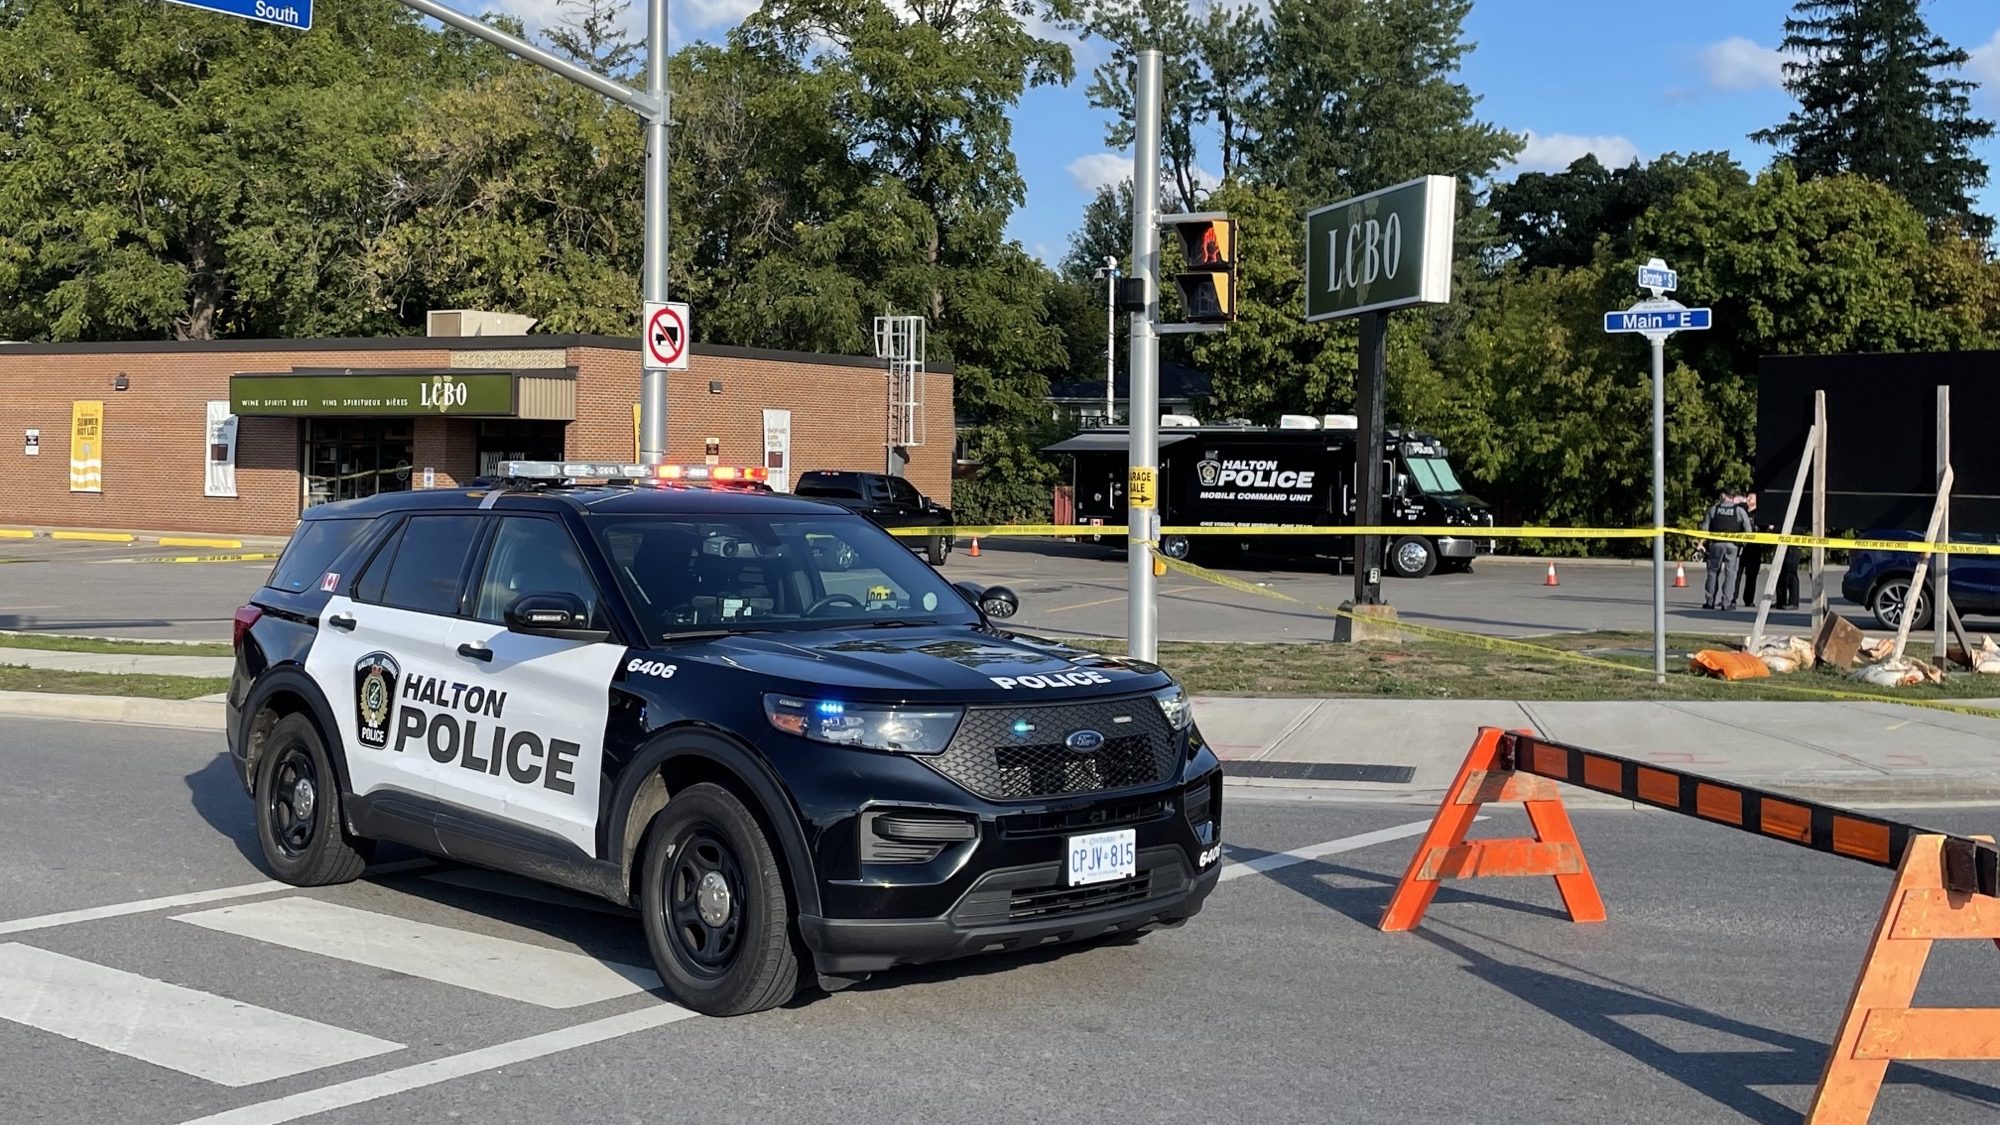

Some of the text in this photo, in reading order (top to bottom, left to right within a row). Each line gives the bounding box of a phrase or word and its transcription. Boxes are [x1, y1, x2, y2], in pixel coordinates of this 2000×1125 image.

[255, 0, 298, 23] South
[1327, 212, 1401, 292] LCBO
[1642, 270, 1663, 286] Bronte
[1668, 273, 1673, 288] S
[1623, 314, 1662, 329] Main
[1680, 312, 1692, 327] E
[421, 382, 467, 406] LCBO
[77, 418, 98, 427] SUMMER
[1222, 460, 1277, 470] HALTON
[1218, 470, 1315, 488] POLICE
[1717, 507, 1734, 516] POLICE
[627, 658, 677, 678] 6406
[989, 671, 1111, 690] POLICE
[403, 673, 507, 719] HALTON
[362, 726, 385, 743] POLICE
[1076, 734, 1097, 747] Ford
[394, 705, 580, 795] POLICE
[1073, 843, 1133, 873] CPJV 815
